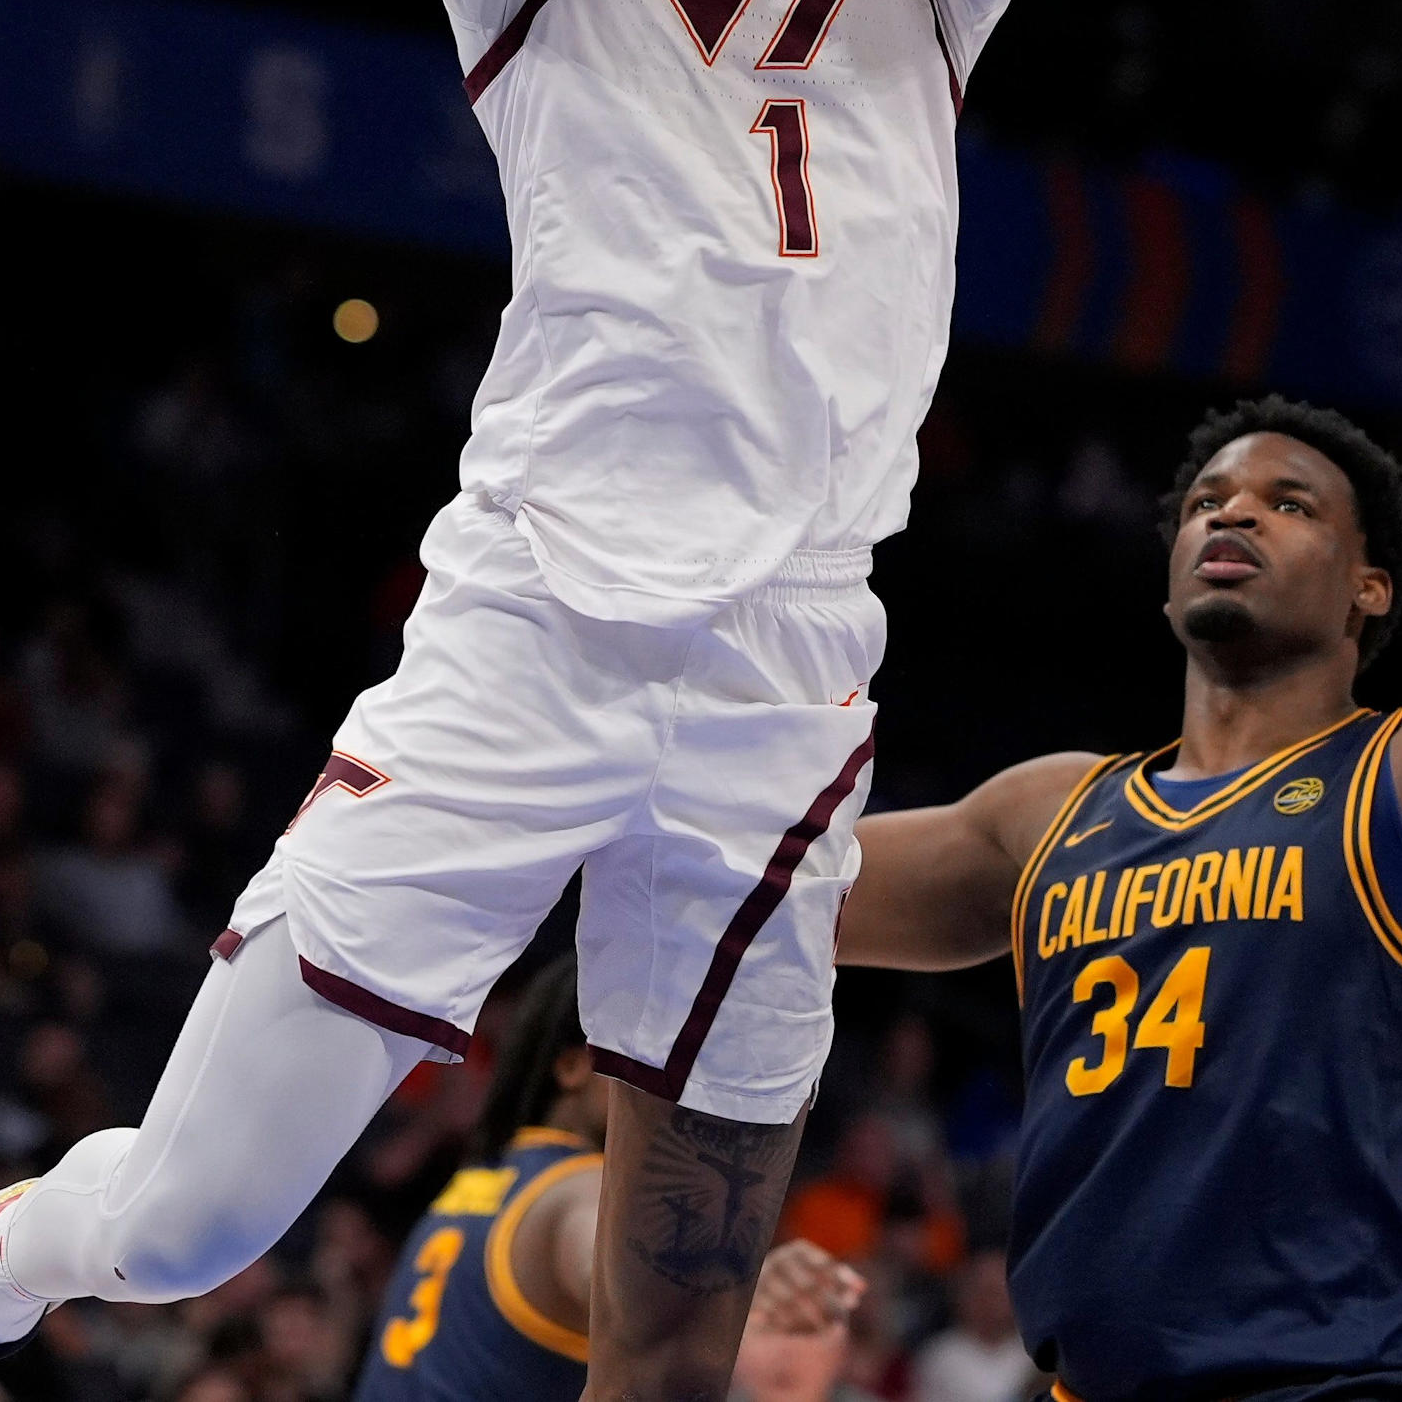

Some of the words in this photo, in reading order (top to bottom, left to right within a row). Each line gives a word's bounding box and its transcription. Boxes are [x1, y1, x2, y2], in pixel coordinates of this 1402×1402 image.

[749, 99, 818, 258] 1
[1037, 846, 1304, 961] CALIFORNIA
[1065, 946, 1211, 1098] 34
[382, 1227, 465, 1368] 3
